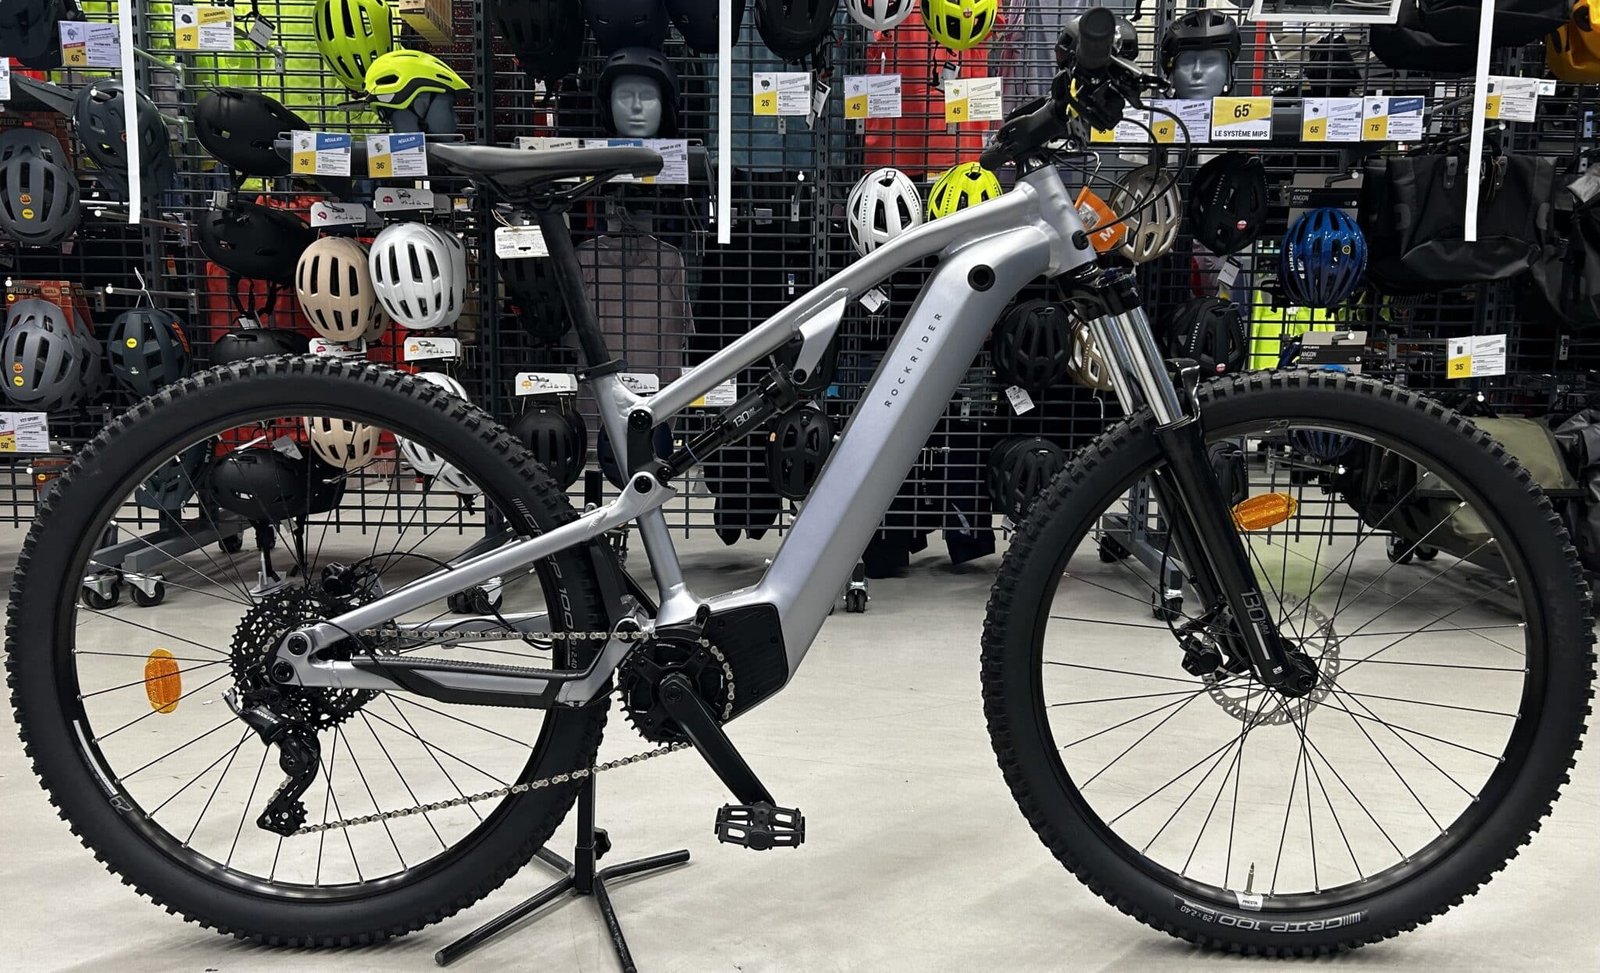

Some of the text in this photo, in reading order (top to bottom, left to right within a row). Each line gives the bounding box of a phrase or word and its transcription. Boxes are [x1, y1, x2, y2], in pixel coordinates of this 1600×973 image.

[852, 103, 861, 111] 45
[952, 106, 961, 114] 45
[1223, 129, 1251, 138] SYSTÈME
[1252, 130, 1268, 138] MIPS
[300, 158, 308, 166] 36
[884, 313, 943, 408] ROCKRIDER
[732, 410, 750, 428] 130
[559, 587, 575, 630] 100
[1240, 586, 1267, 622] 130
[1180, 905, 1198, 917] 2.40
[1202, 913, 1214, 923] 29
[1218, 915, 1261, 931] 100
[1270, 917, 1343, 932] GRIP
